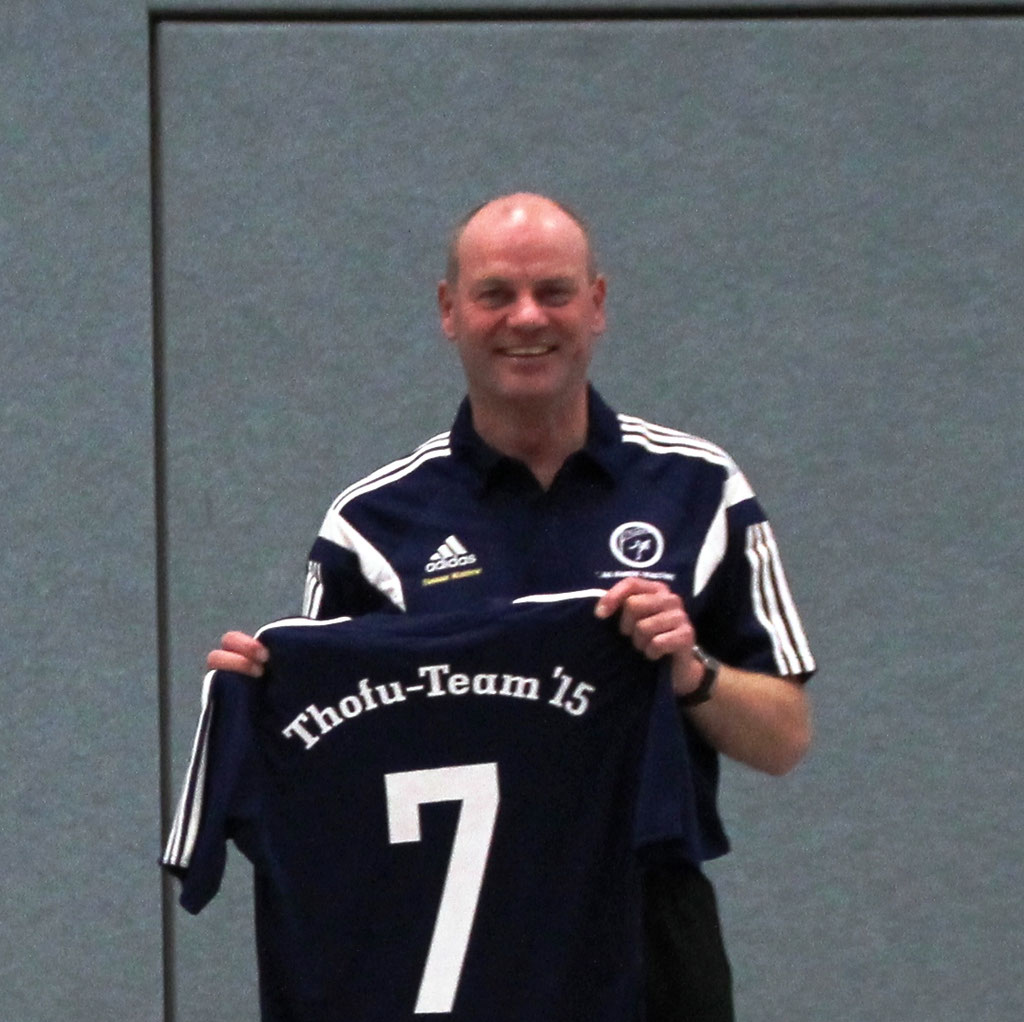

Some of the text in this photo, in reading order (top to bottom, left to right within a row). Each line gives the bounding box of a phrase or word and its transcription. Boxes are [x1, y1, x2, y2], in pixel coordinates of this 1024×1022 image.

[425, 554, 477, 572] adidas
[281, 664, 540, 749] Thofu-Team
[384, 762, 499, 1014] 7
